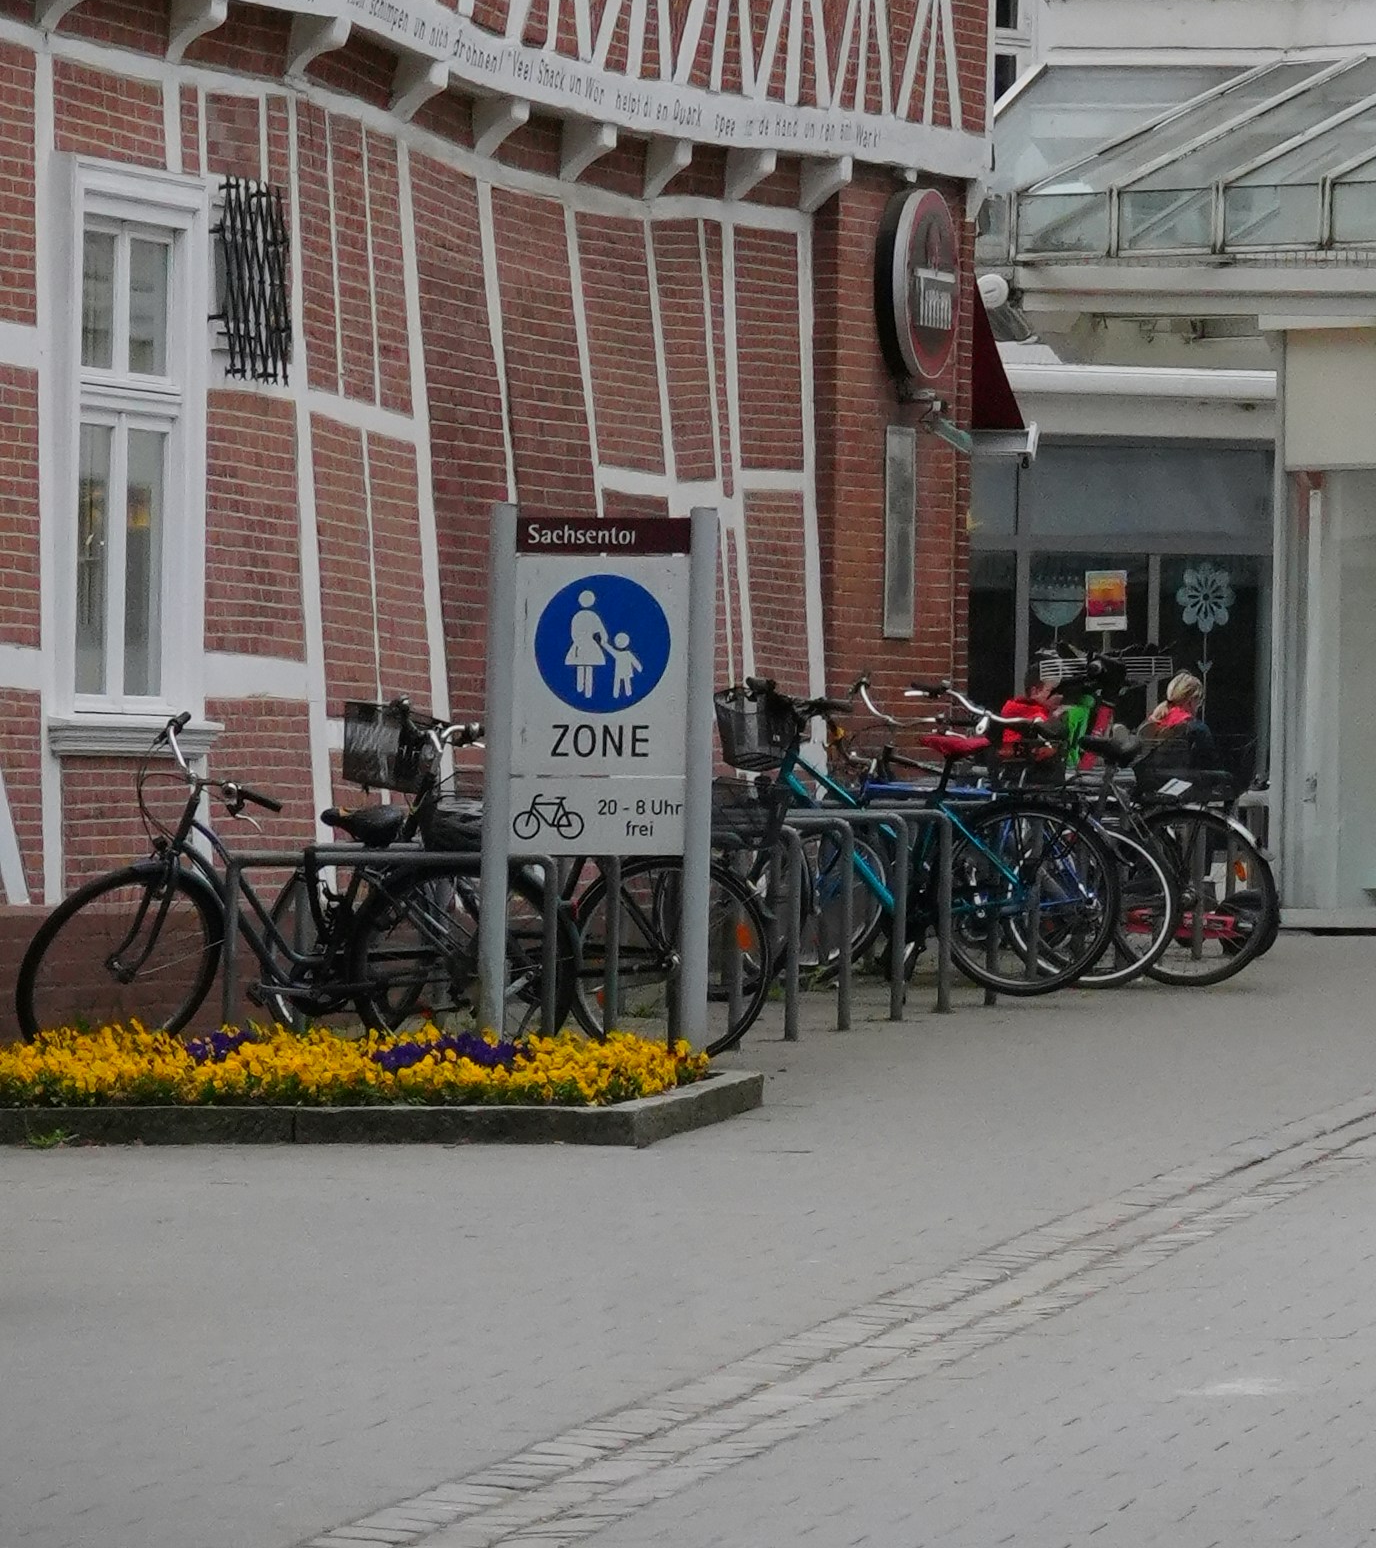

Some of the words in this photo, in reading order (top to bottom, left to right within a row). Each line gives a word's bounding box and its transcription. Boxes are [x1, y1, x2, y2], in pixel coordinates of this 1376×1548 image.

[413, 17, 426, 40] un
[569, 75, 581, 96] un
[550, 724, 650, 758] ZONE
[597, 799, 618, 816] 20
[635, 799, 646, 816] 8
[651, 799, 683, 816] Uhr
[625, 820, 654, 837] frei
